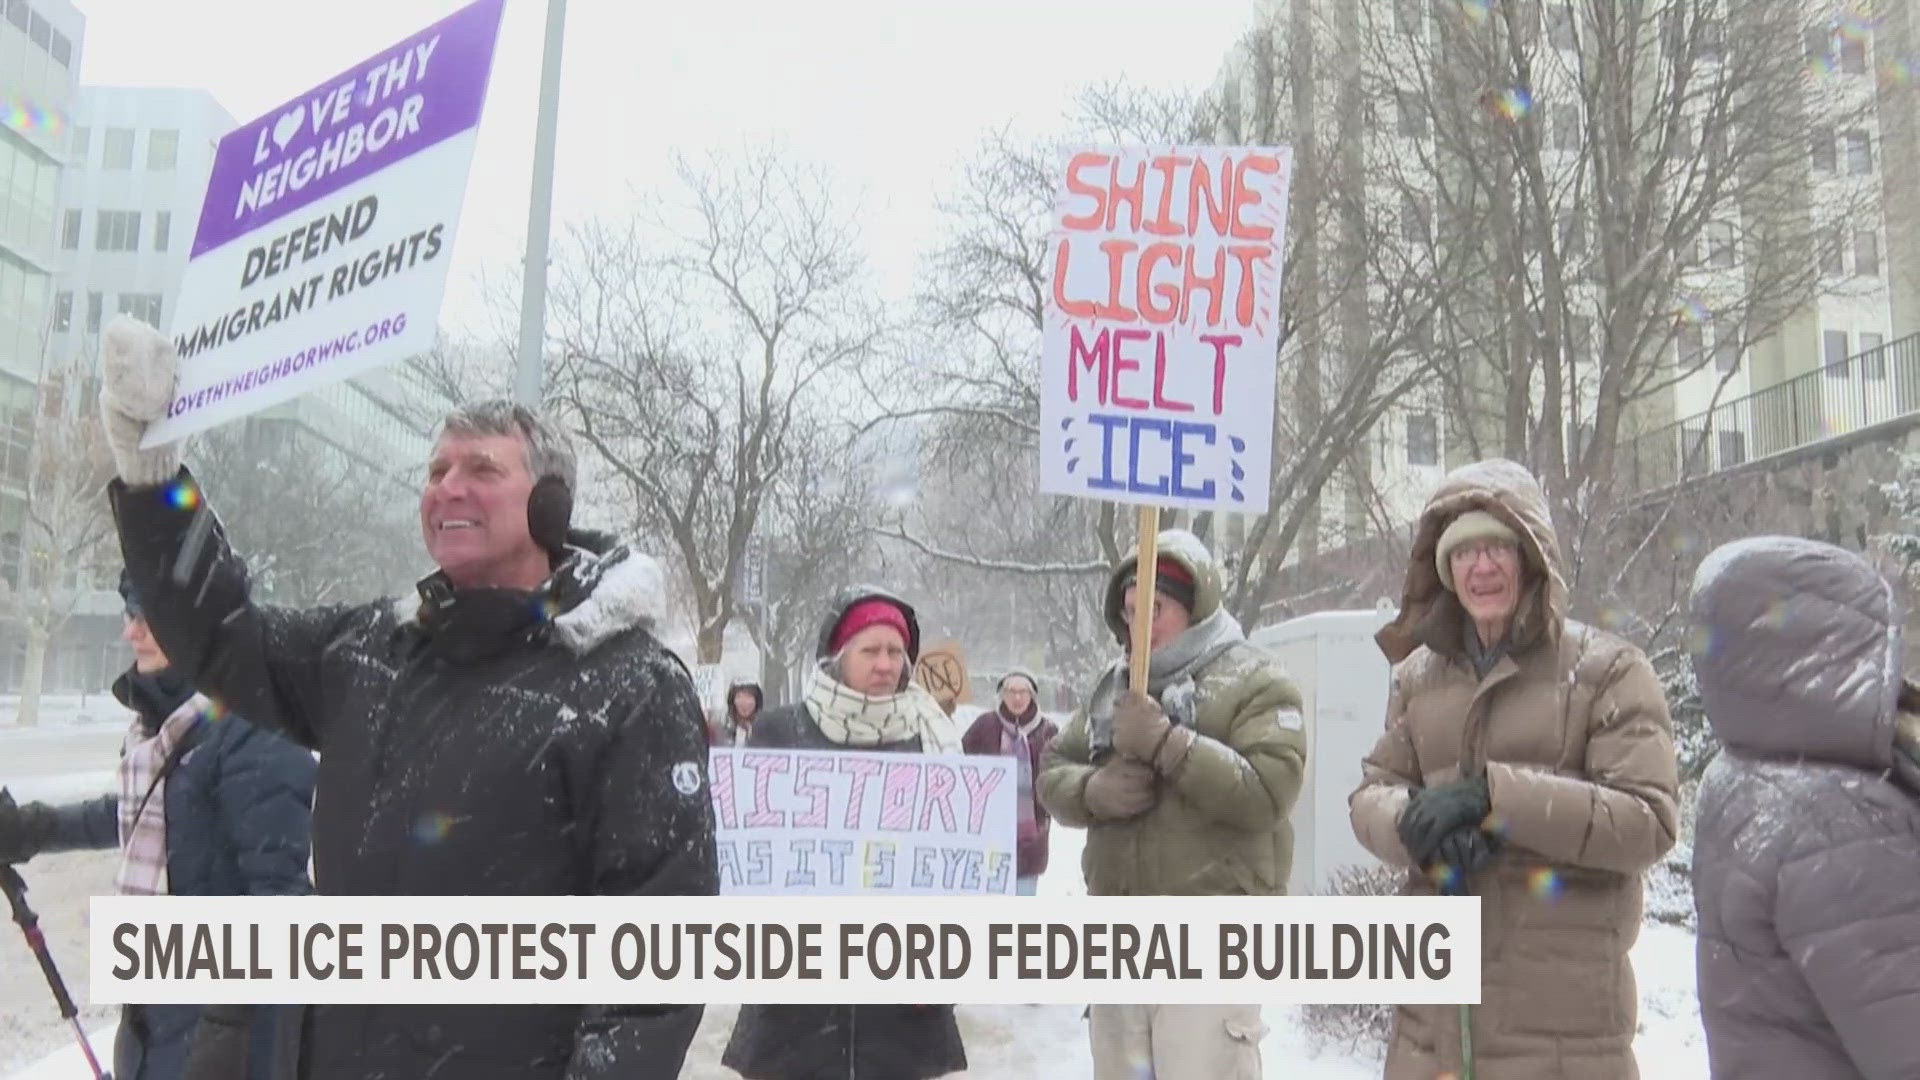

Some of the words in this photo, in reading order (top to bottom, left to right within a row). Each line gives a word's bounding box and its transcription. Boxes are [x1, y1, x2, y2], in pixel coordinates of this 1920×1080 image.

[364, 35, 440, 105] THY
[234, 93, 424, 220] NEIGHBOR
[1061, 152, 1280, 241] SHINE
[239, 194, 379, 290] DEFEND
[328, 223, 445, 302] RIGHTS
[1053, 238, 1272, 328] LIGHT
[166, 312, 407, 420] LOVETHYNEIGHBORWNC.ORG
[1067, 324, 1243, 416] MELT
[1087, 413, 1216, 500] ICE
[717, 840, 773, 887] AS
[911, 846, 1012, 894] EYES
